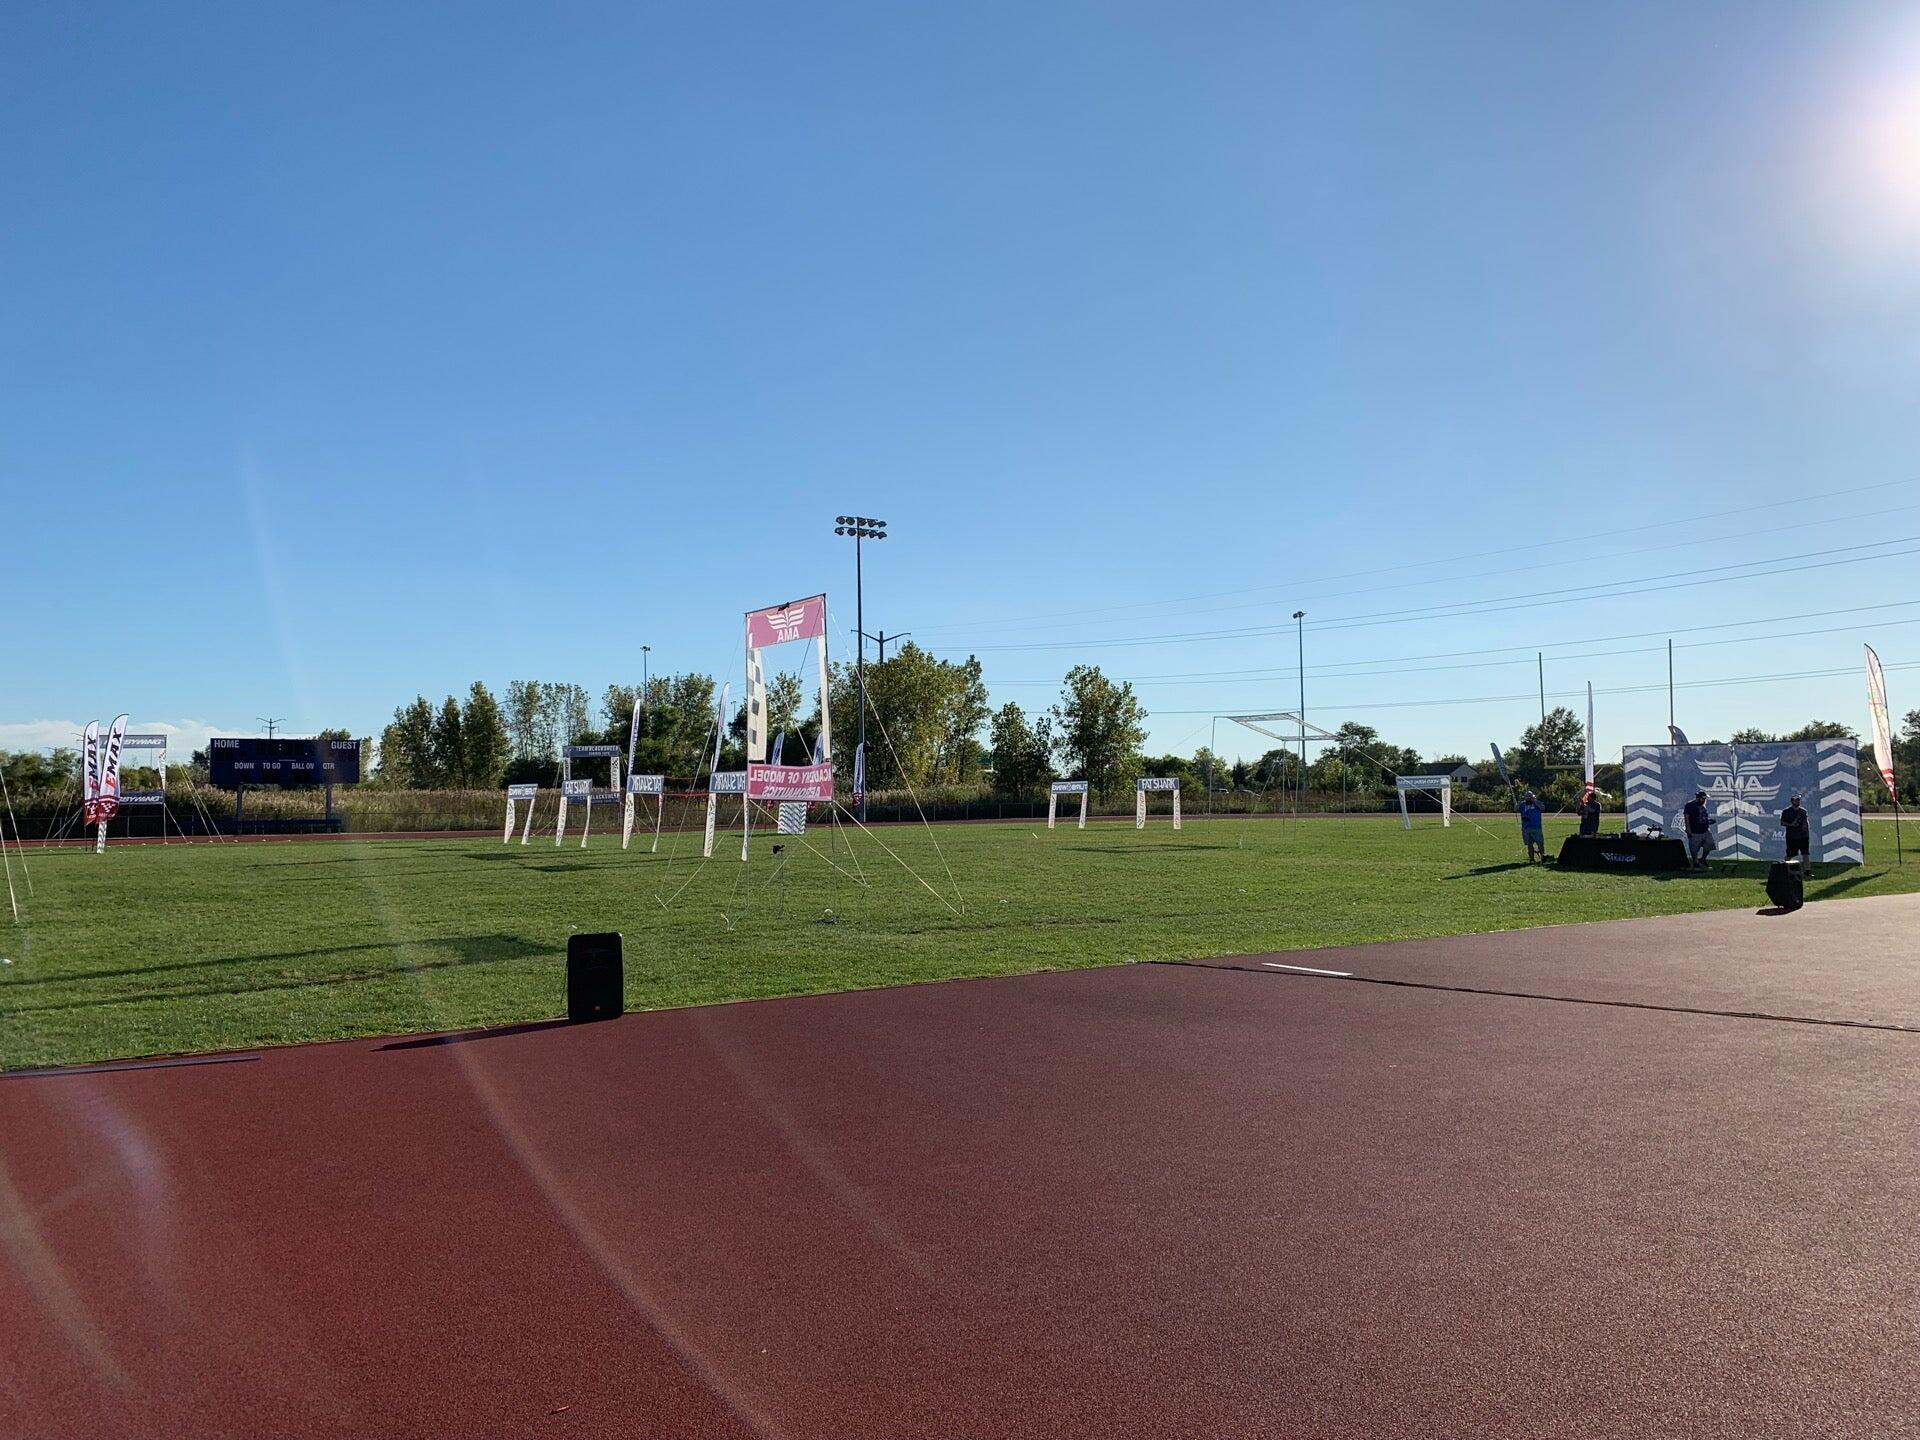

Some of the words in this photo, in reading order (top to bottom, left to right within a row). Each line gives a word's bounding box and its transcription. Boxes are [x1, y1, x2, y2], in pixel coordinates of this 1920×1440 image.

[214, 740, 240, 748] HOME
[331, 741, 357, 750] GUEST
[105, 727, 122, 788] EMAX
[1712, 775, 1762, 790] AMA
